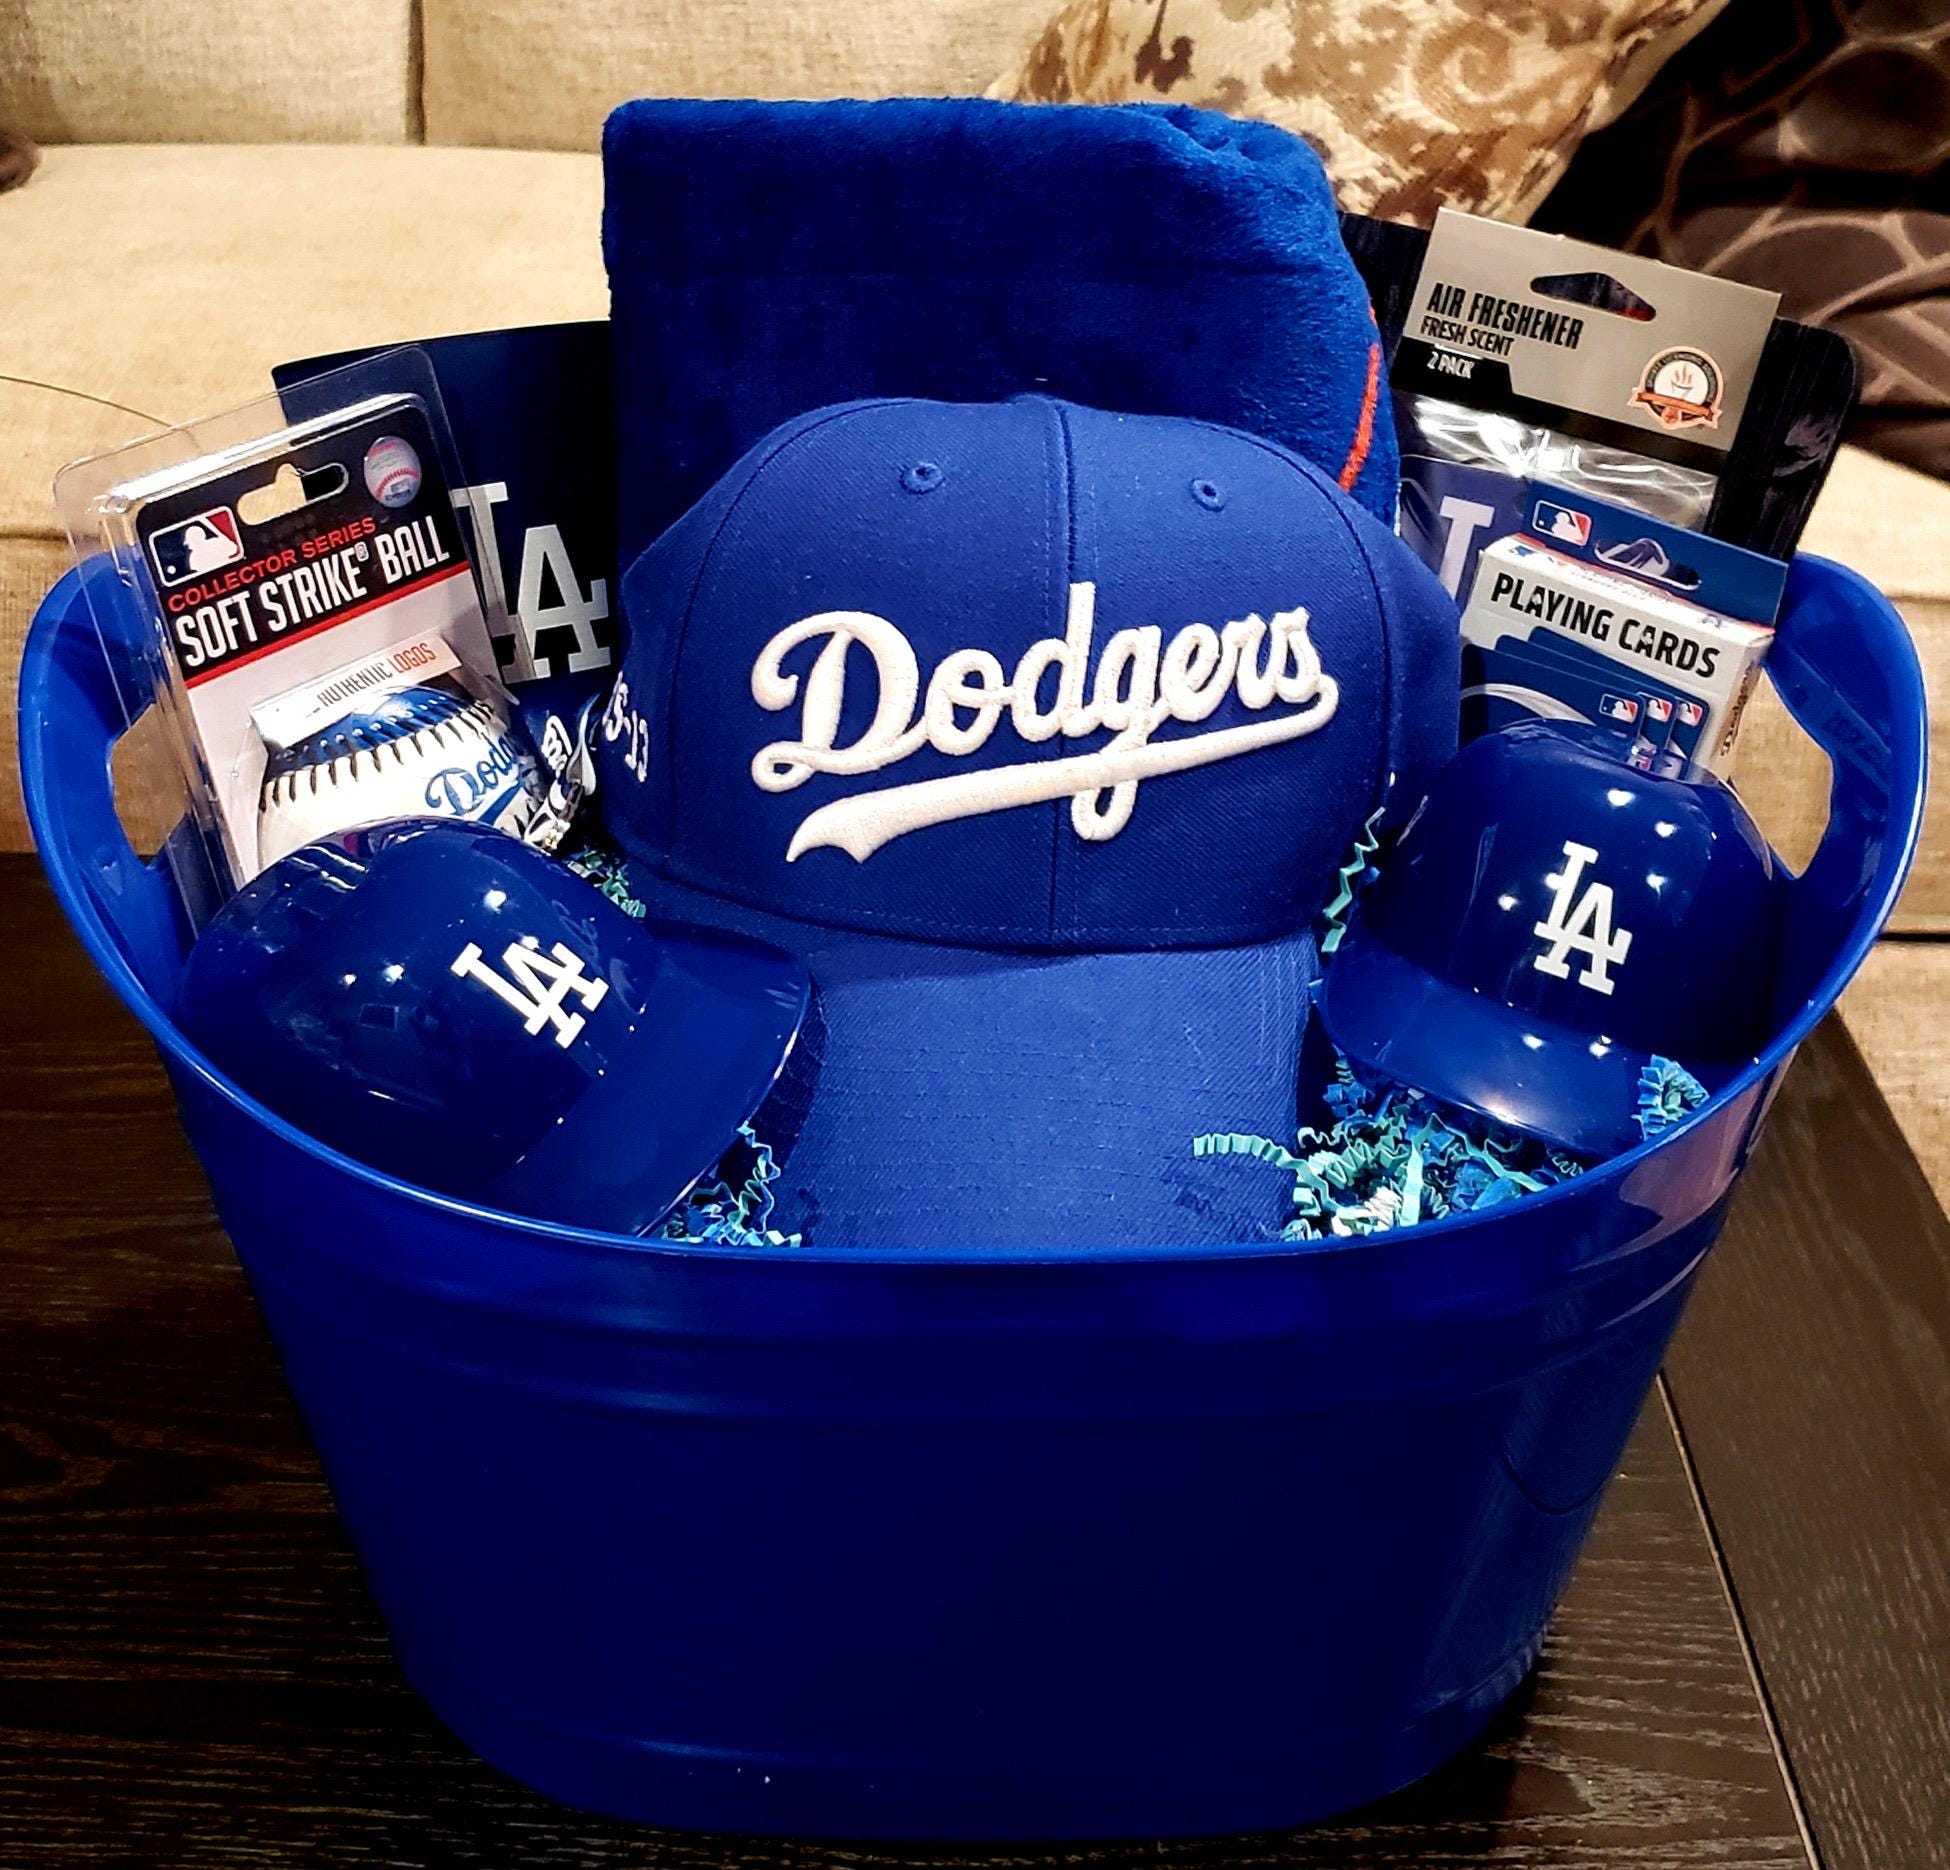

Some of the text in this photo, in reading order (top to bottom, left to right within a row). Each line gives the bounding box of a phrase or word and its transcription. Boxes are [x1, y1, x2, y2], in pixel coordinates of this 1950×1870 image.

[1420, 315, 1515, 357] FRESH SCENT
[1426, 282, 1585, 350] AIR FRESHENER
[1427, 351, 1476, 379] 2 PACK
[168, 516, 377, 612] COLLECTOR SERIES
[175, 590, 258, 668] SOFT
[374, 515, 450, 584] BALL
[451, 481, 611, 684] LA
[317, 642, 437, 708] AUTHENTIC LOGOS
[1491, 571, 1616, 643] PLAYING
[1618, 617, 1720, 679] CARDS
[752, 581, 1339, 841] Dodgers
[1533, 840, 1633, 996] LA
[450, 942, 610, 1050] LA
